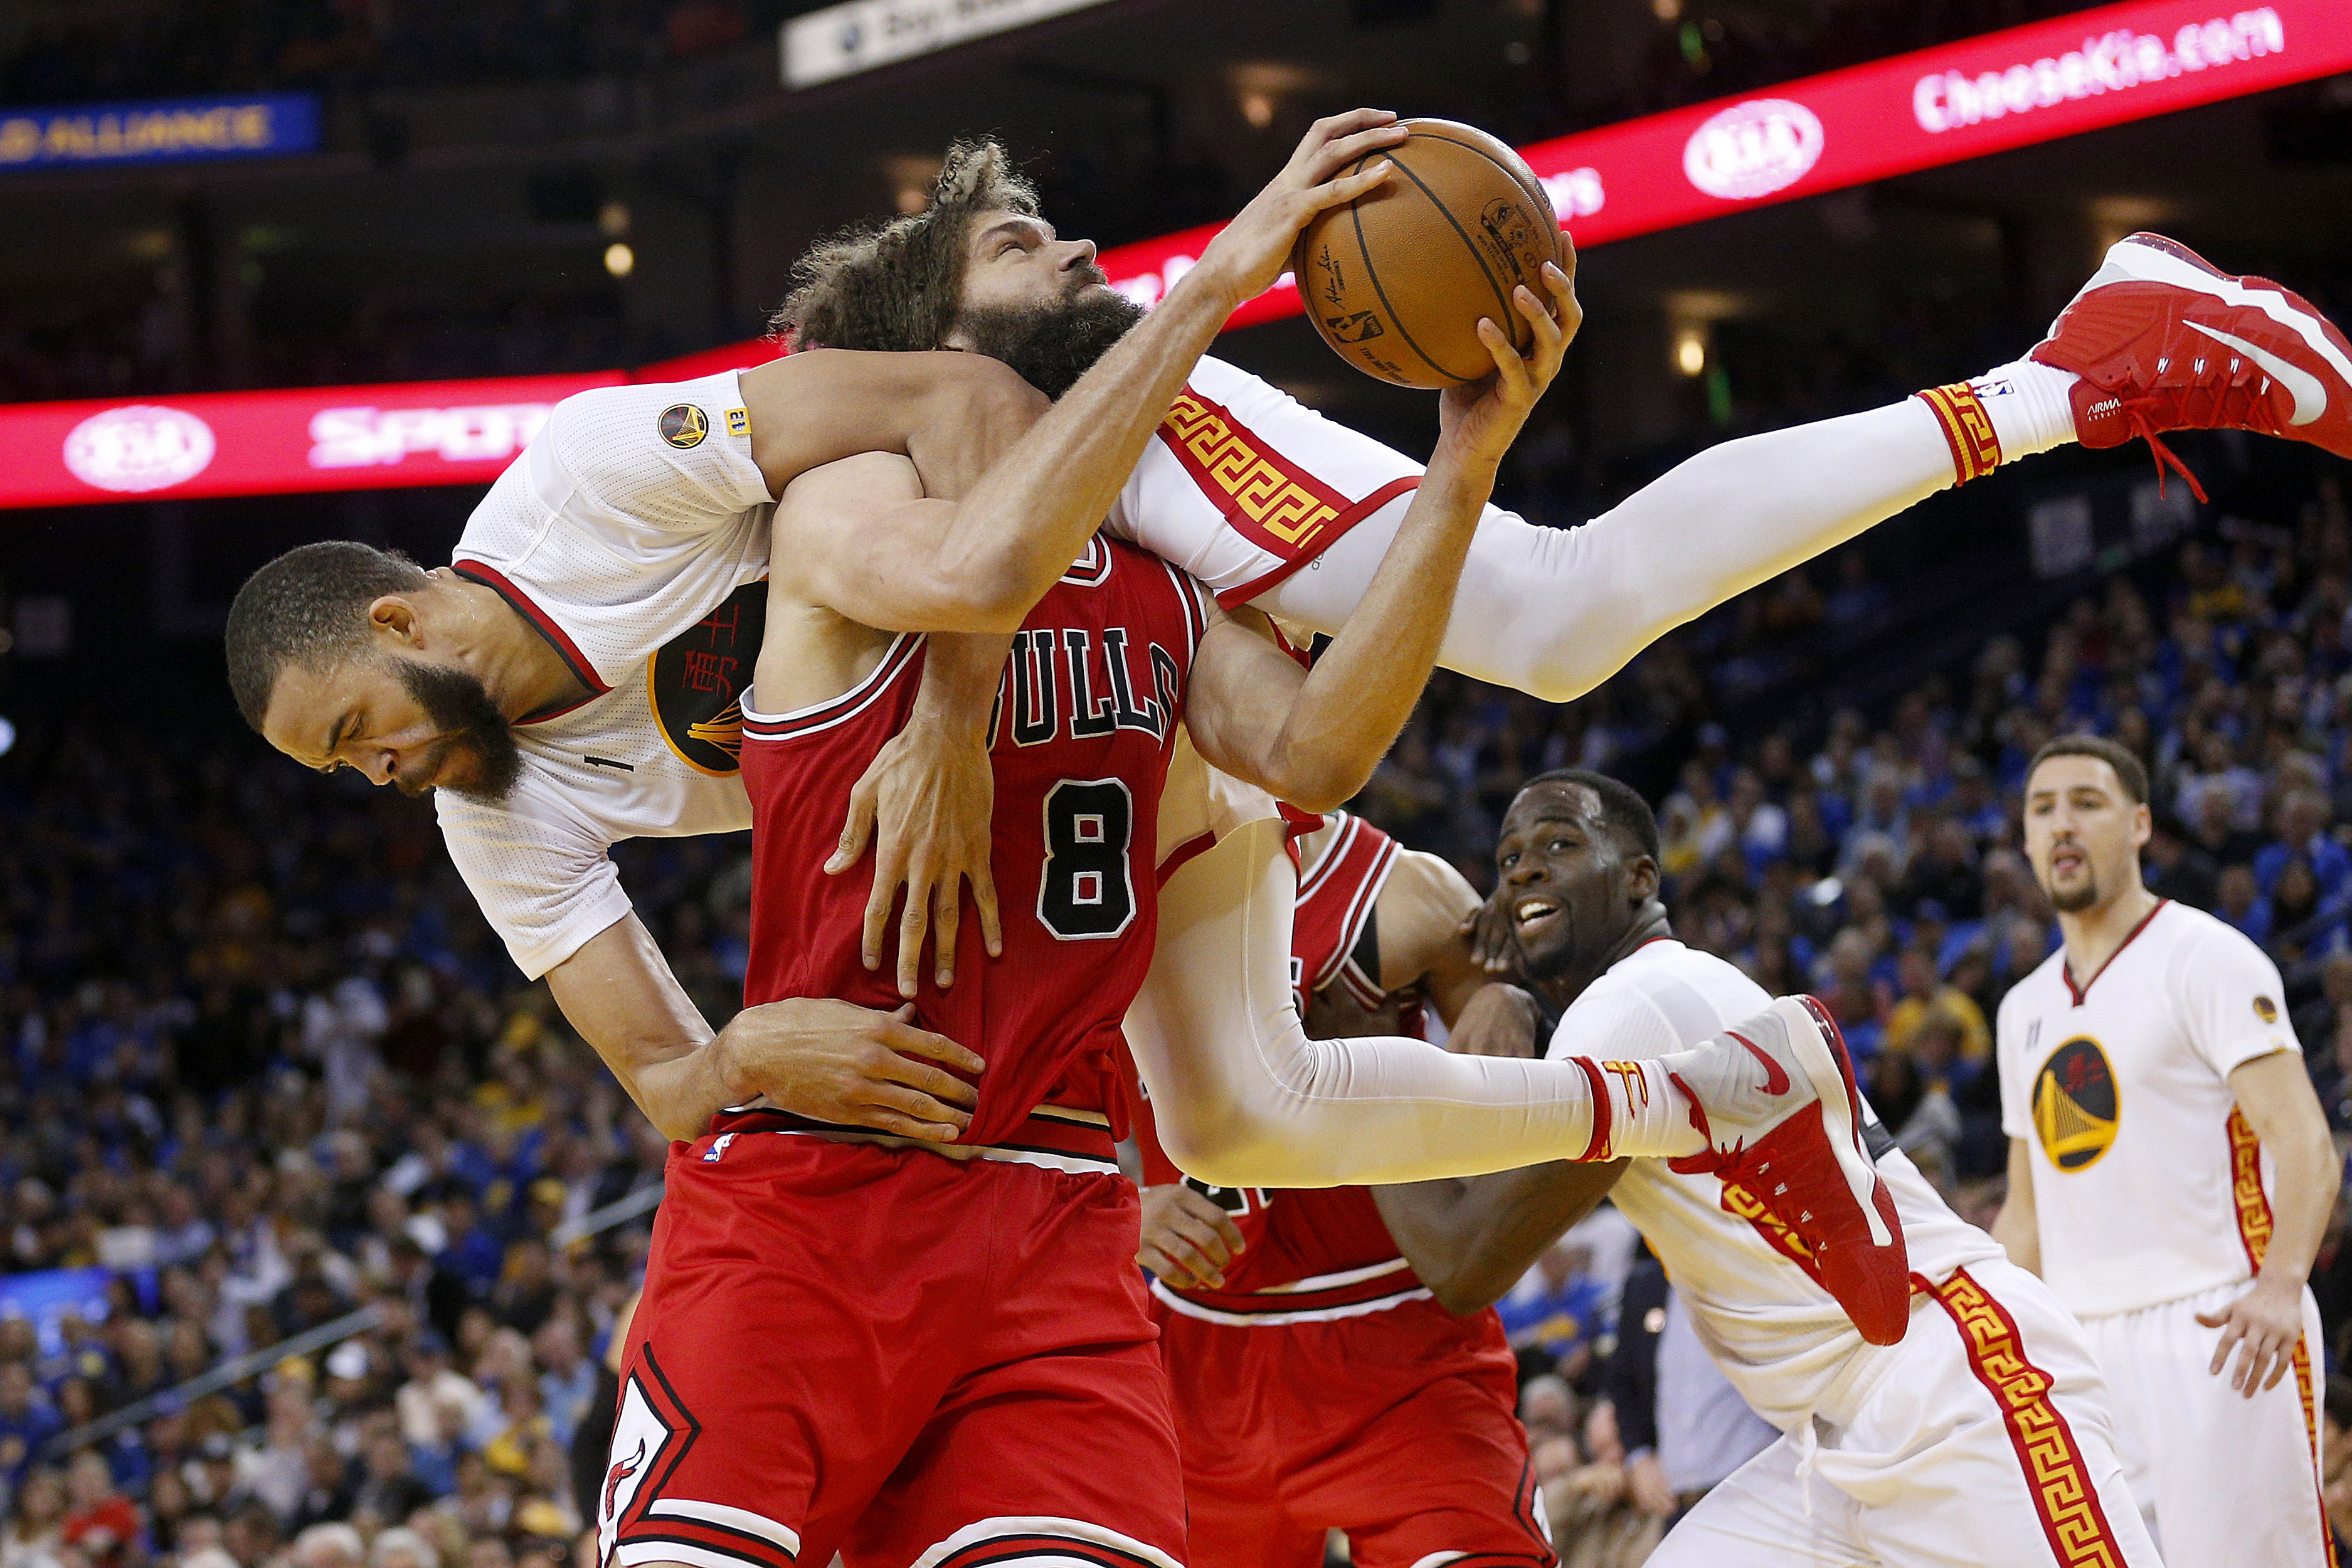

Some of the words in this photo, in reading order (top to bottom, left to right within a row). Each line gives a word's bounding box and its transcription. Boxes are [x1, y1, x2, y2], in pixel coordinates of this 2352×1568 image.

[683, 604, 739, 701] 勇士
[584, 754, 634, 772] 1
[1036, 777, 1136, 941] 8
